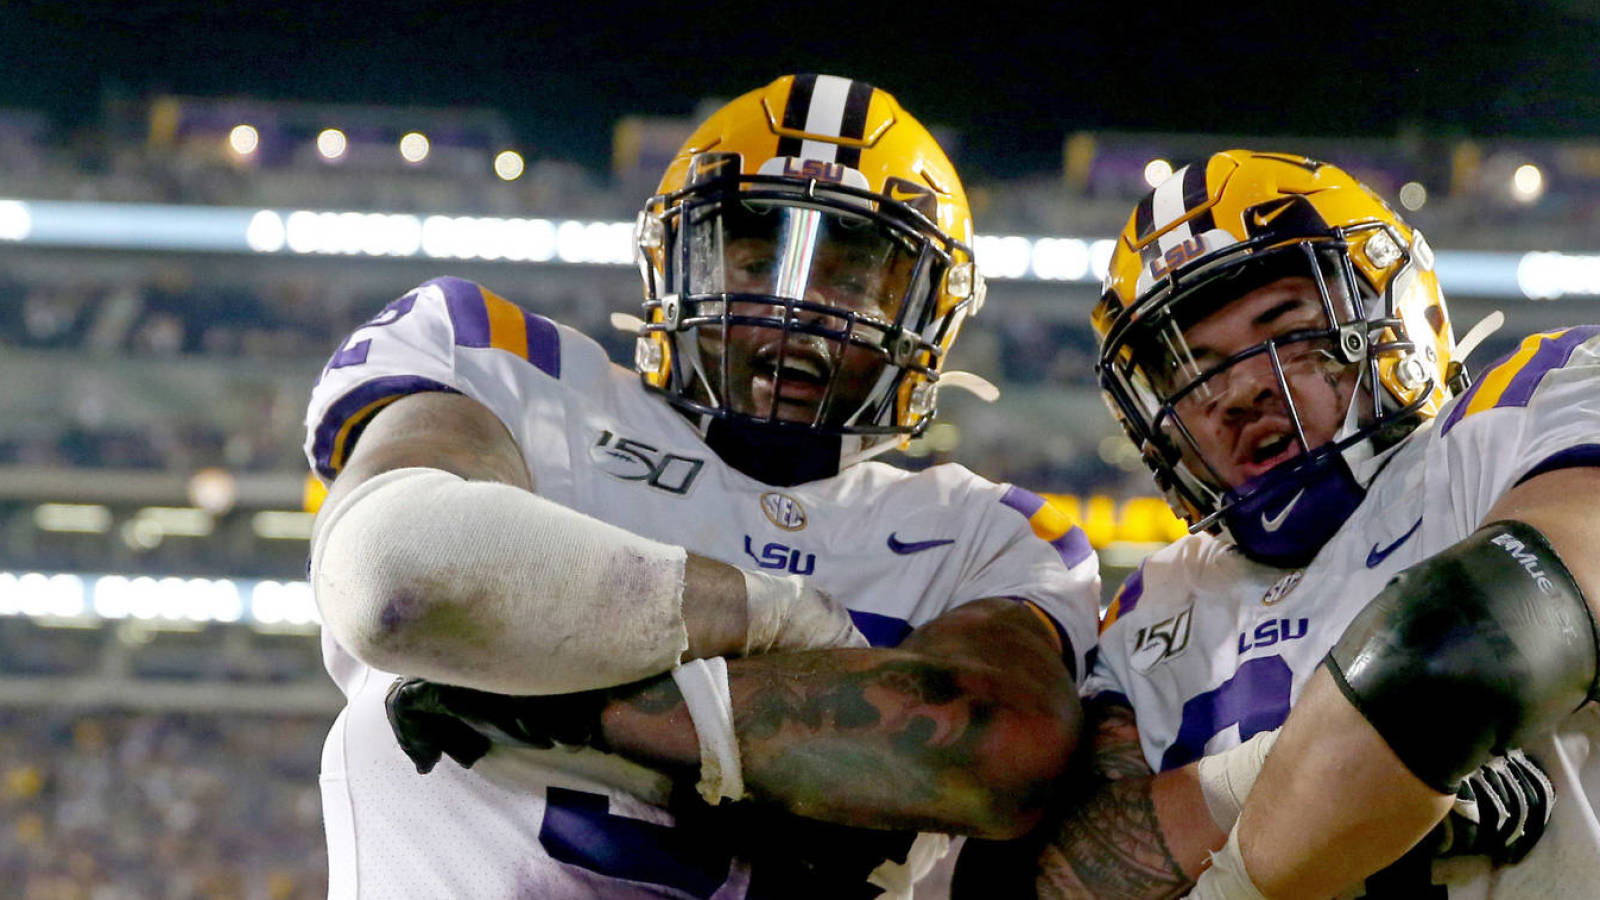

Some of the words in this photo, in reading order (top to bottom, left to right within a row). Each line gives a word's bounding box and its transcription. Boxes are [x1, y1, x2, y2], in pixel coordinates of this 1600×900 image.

[783, 156, 845, 183] LSU
[1150, 235, 1207, 281] LSU
[596, 429, 705, 494] 150
[743, 534, 816, 576] LSU
[1132, 602, 1195, 674] 150
[1238, 617, 1310, 656] LSU
